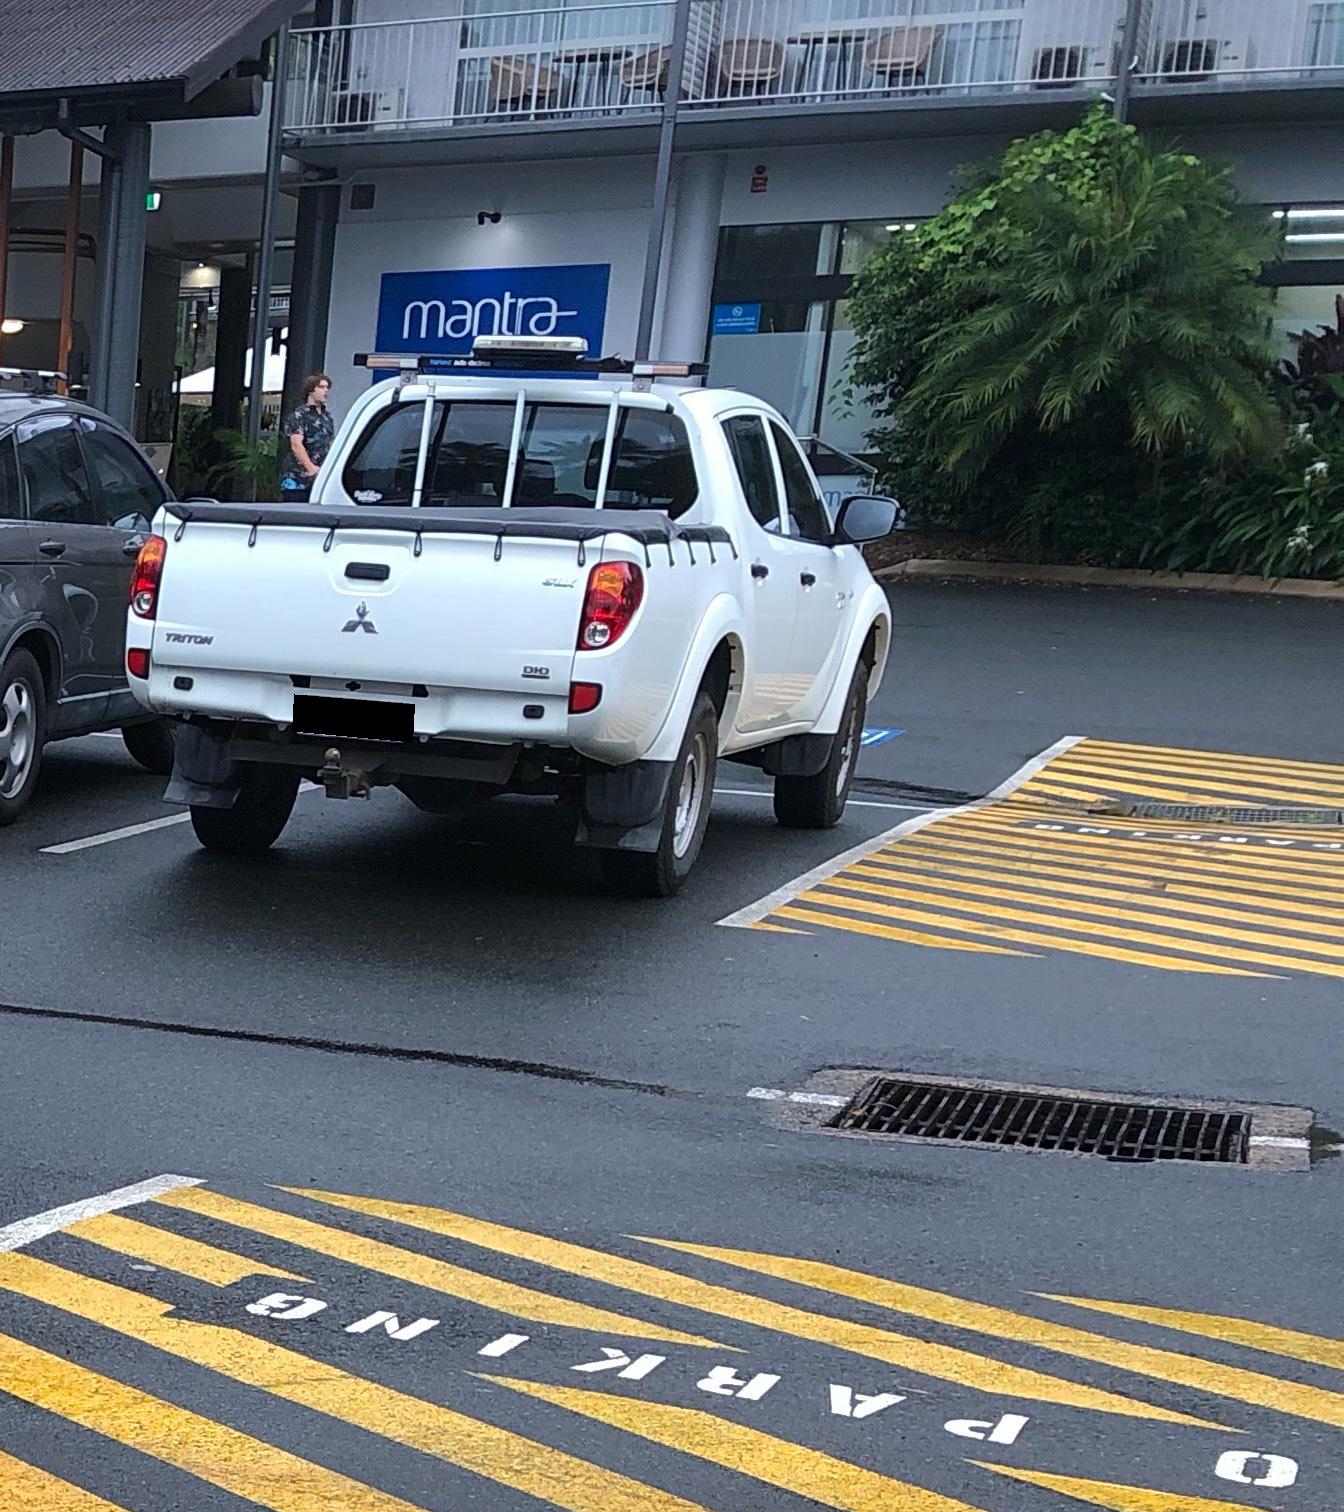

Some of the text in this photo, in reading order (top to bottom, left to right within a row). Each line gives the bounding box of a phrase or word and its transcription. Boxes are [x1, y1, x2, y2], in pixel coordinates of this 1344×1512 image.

[403, 291, 578, 339] mantra
[165, 632, 214, 646] TRITON
[1033, 823, 1342, 849] PARKING
[245, 1290, 1299, 1488] O PARKING
